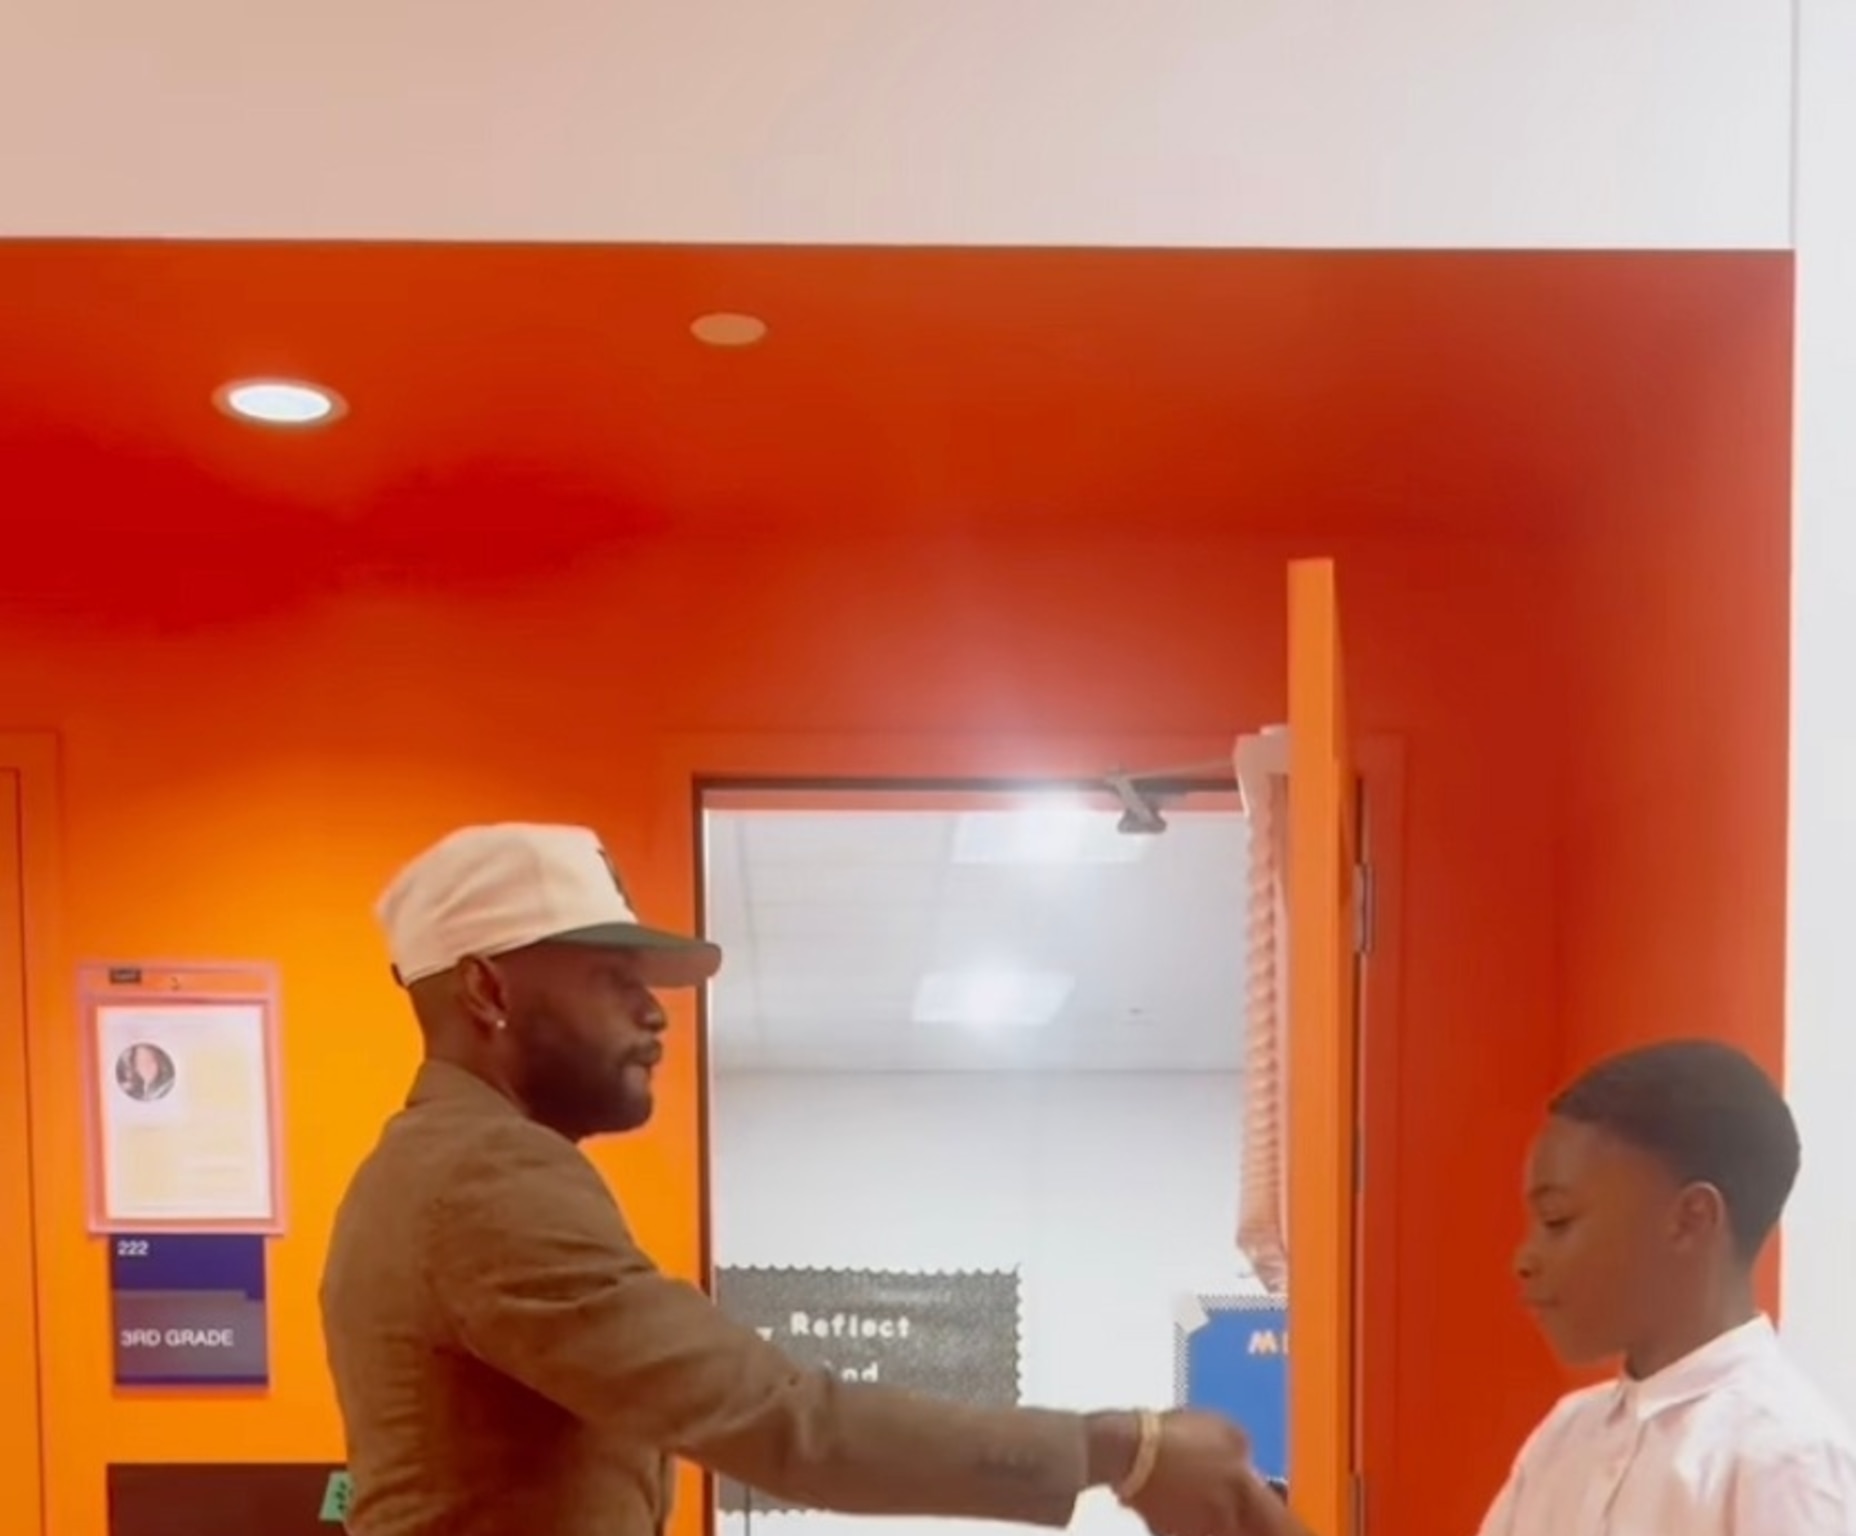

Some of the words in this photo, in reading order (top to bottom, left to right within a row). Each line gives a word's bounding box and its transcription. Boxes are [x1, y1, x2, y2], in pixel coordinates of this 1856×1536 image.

[117, 1240, 148, 1256] 222
[790, 1311, 910, 1338] Reflect
[121, 1328, 161, 1347] 3RD
[165, 1328, 234, 1347] GRADE
